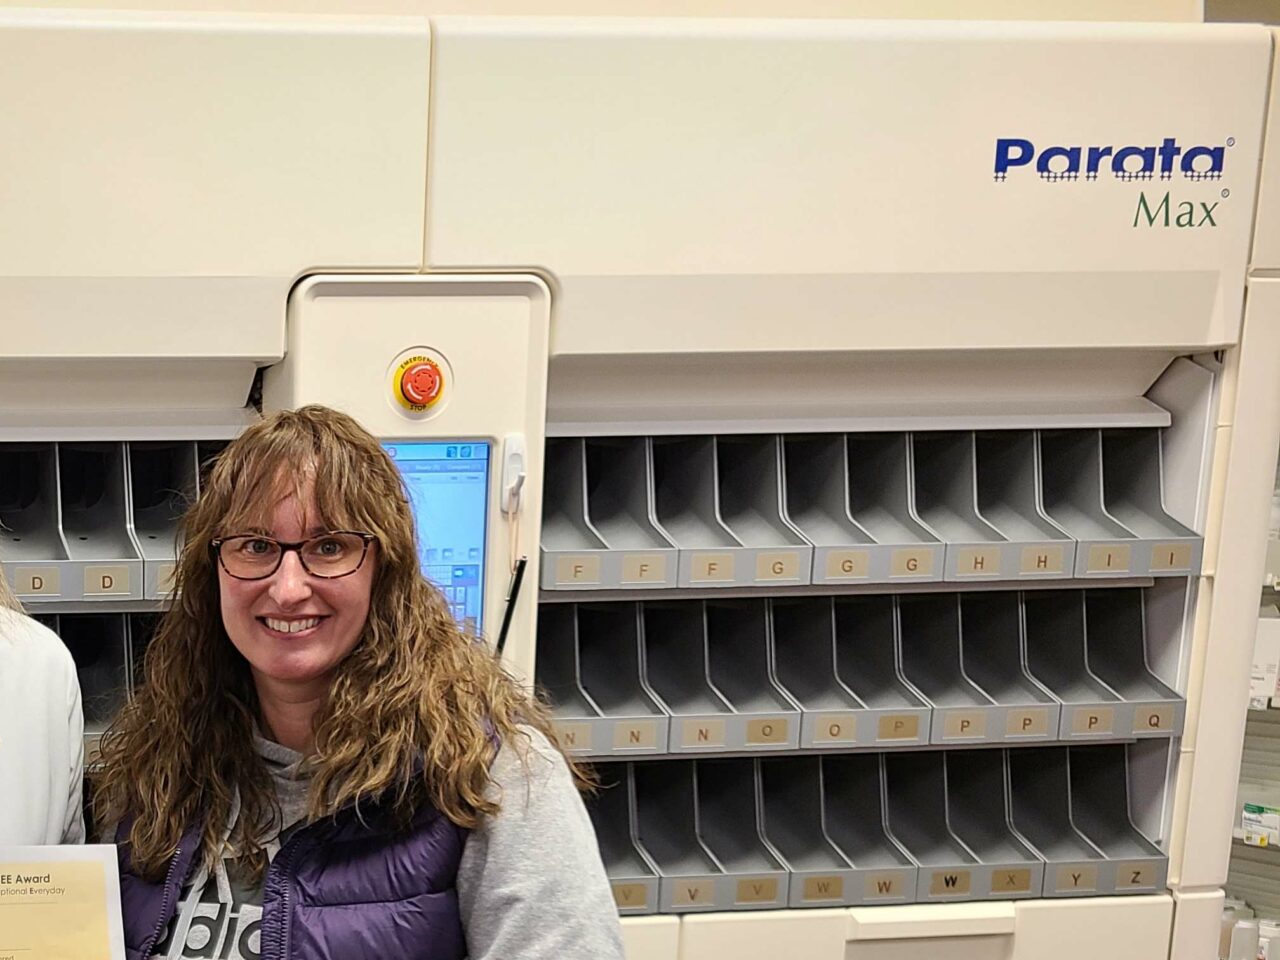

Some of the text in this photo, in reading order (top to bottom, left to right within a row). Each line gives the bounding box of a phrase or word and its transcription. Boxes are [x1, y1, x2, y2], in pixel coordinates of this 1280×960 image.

[994, 138, 1226, 182] Parata
[1133, 191, 1219, 228] Max
[772, 562, 784, 574] G
[841, 560, 854, 573] G
[906, 558, 918, 572] G
[974, 556, 984, 570] H
[1036, 556, 1048, 568] H
[573, 565, 584, 578] F
[638, 564, 649, 578] F
[707, 562, 718, 576] F
[32, 576, 43, 590] D
[102, 576, 113, 589] D
[960, 720, 970, 732] P
[1022, 718, 1032, 730] P
[1088, 716, 1098, 729] P
[1148, 714, 1160, 728] Q
[698, 729, 708, 742] N
[829, 724, 841, 736] O
[564, 733, 575, 745] N
[630, 731, 640, 743] N
[16, 874, 50, 884] Award
[944, 875, 958, 888] W
[1072, 873, 1082, 886] Y
[1130, 871, 1141, 884] Z
[30, 886, 66, 896] Everyday
[687, 888, 698, 900] V
[877, 881, 892, 894] W
